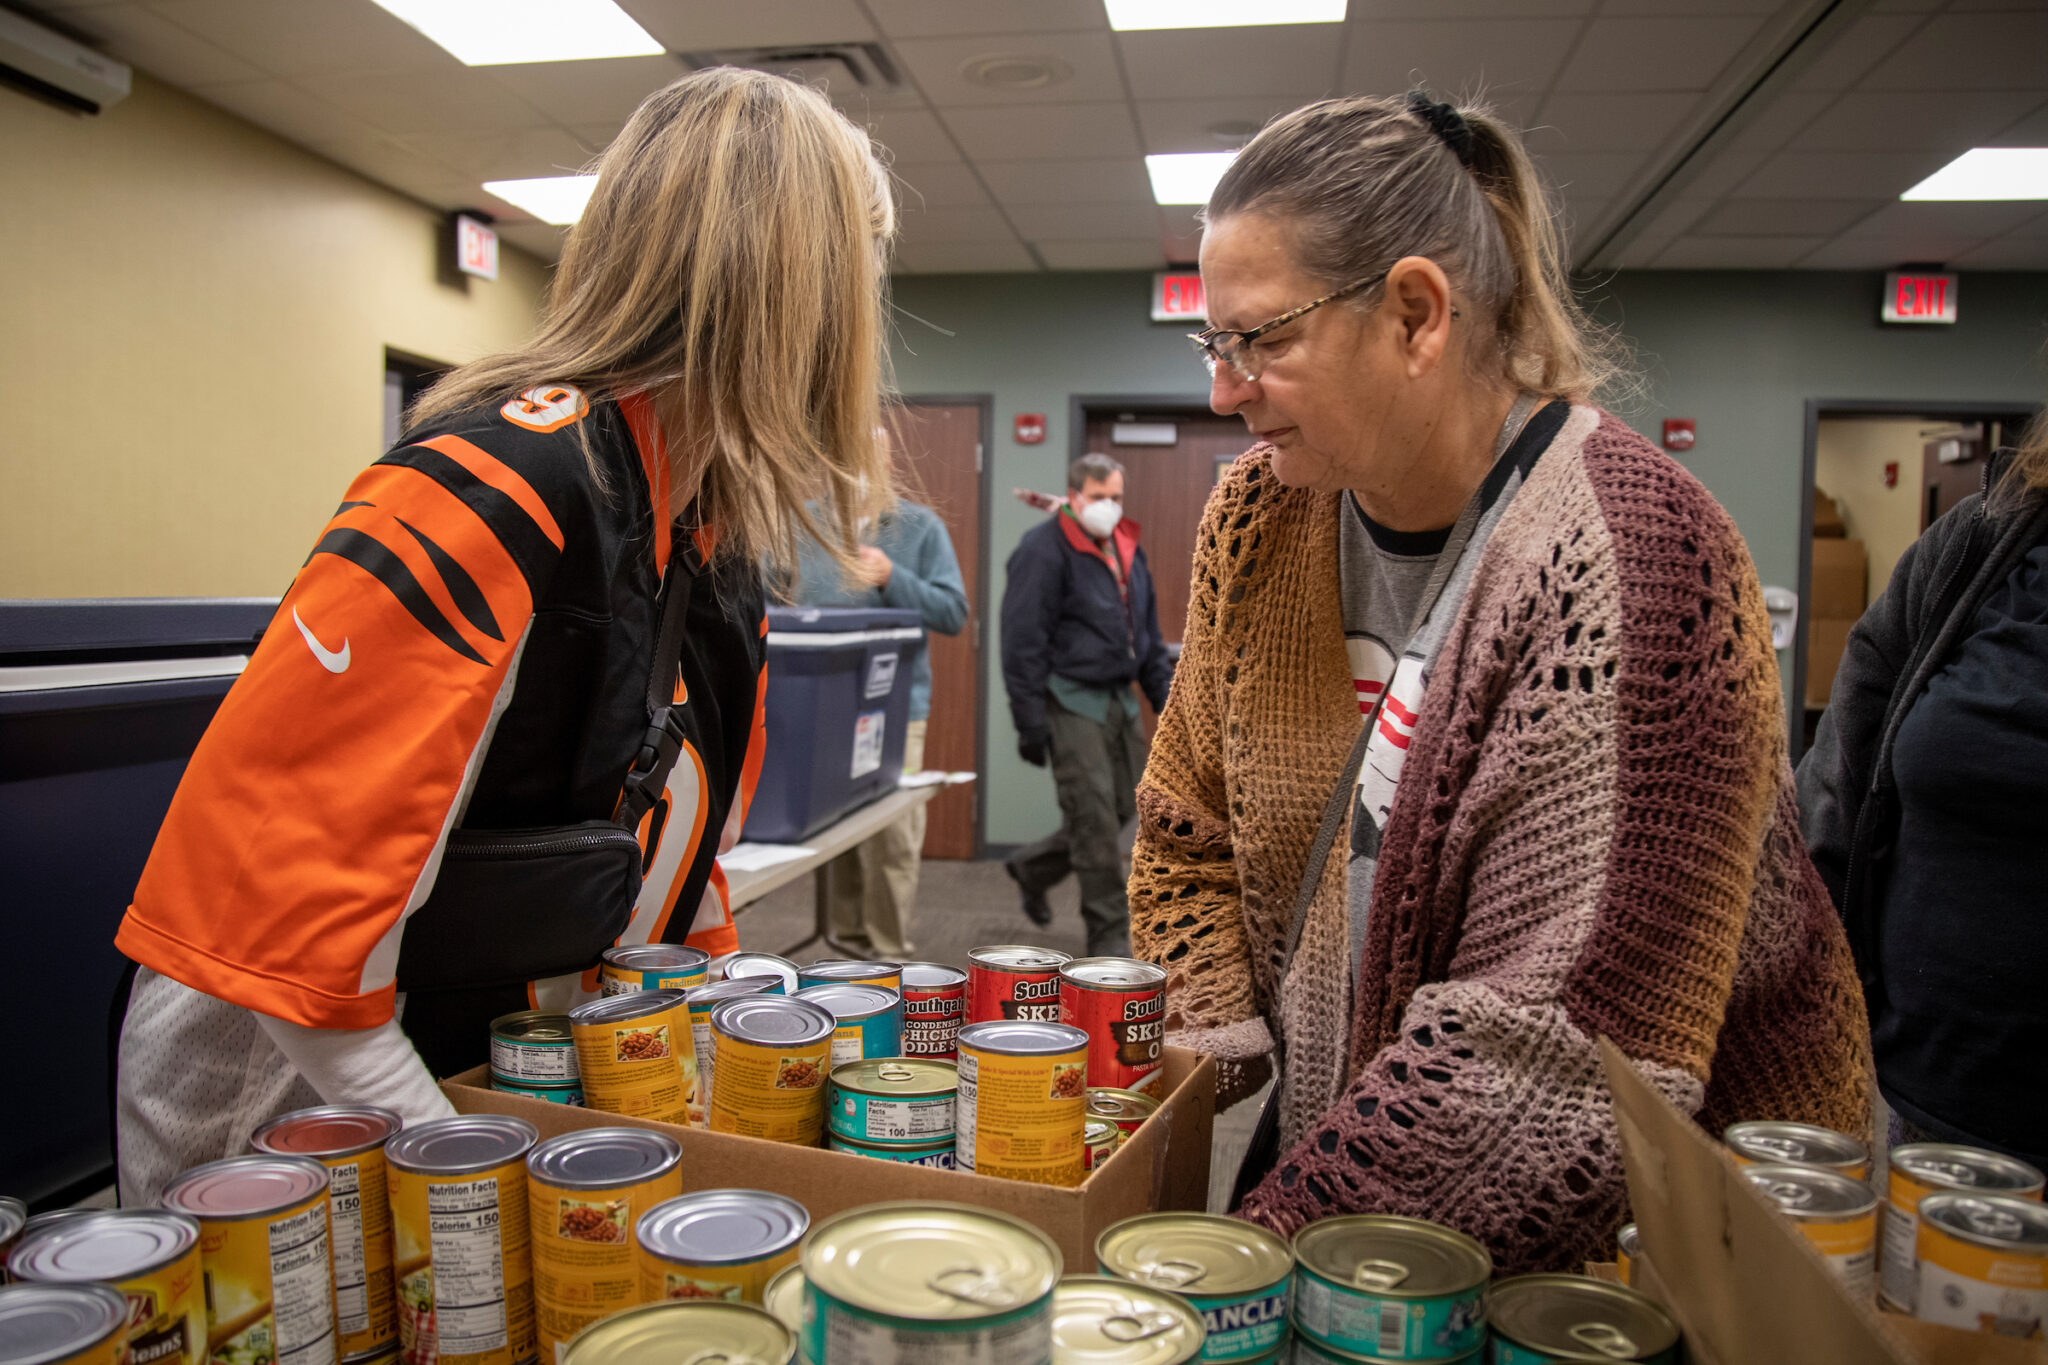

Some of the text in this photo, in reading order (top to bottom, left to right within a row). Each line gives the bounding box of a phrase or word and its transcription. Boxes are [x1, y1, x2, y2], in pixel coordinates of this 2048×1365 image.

[1896, 276, 1949, 316] EXIT
[906, 1019, 960, 1030] CONDENSED
[1126, 1020, 1162, 1043] SKE
[964, 1086, 977, 1098] 150
[868, 1101, 897, 1109] Nutrition
[889, 1128, 906, 1137] 100
[332, 1166, 358, 1179] Facts
[428, 1180, 497, 1196] Nutrition Facts
[337, 1197, 360, 1211] 150
[270, 1215, 308, 1235] Nutrition
[431, 1221, 471, 1231] Calories
[476, 1212, 499, 1227] 150
[273, 1253, 311, 1273] Calories
